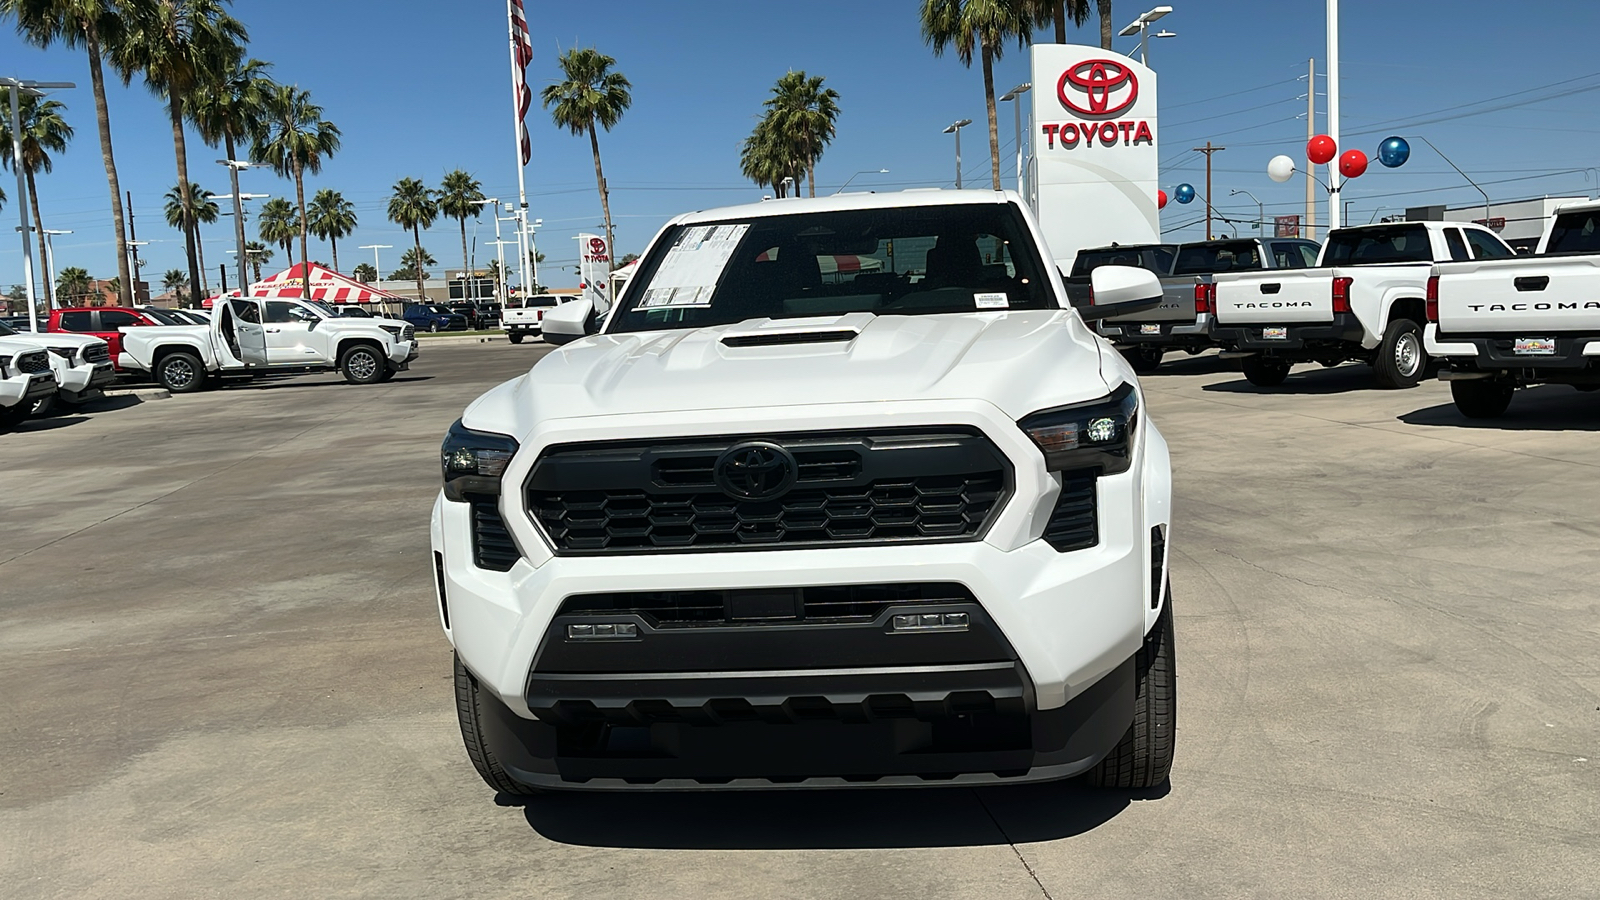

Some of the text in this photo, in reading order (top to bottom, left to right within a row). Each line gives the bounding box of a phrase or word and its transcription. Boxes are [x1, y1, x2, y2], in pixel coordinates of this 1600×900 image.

[1042, 121, 1153, 149] TOYOTA
[584, 254, 609, 263] TYOTA
[1233, 301, 1312, 309] TACOMA
[1468, 301, 1600, 311] TACOMA
